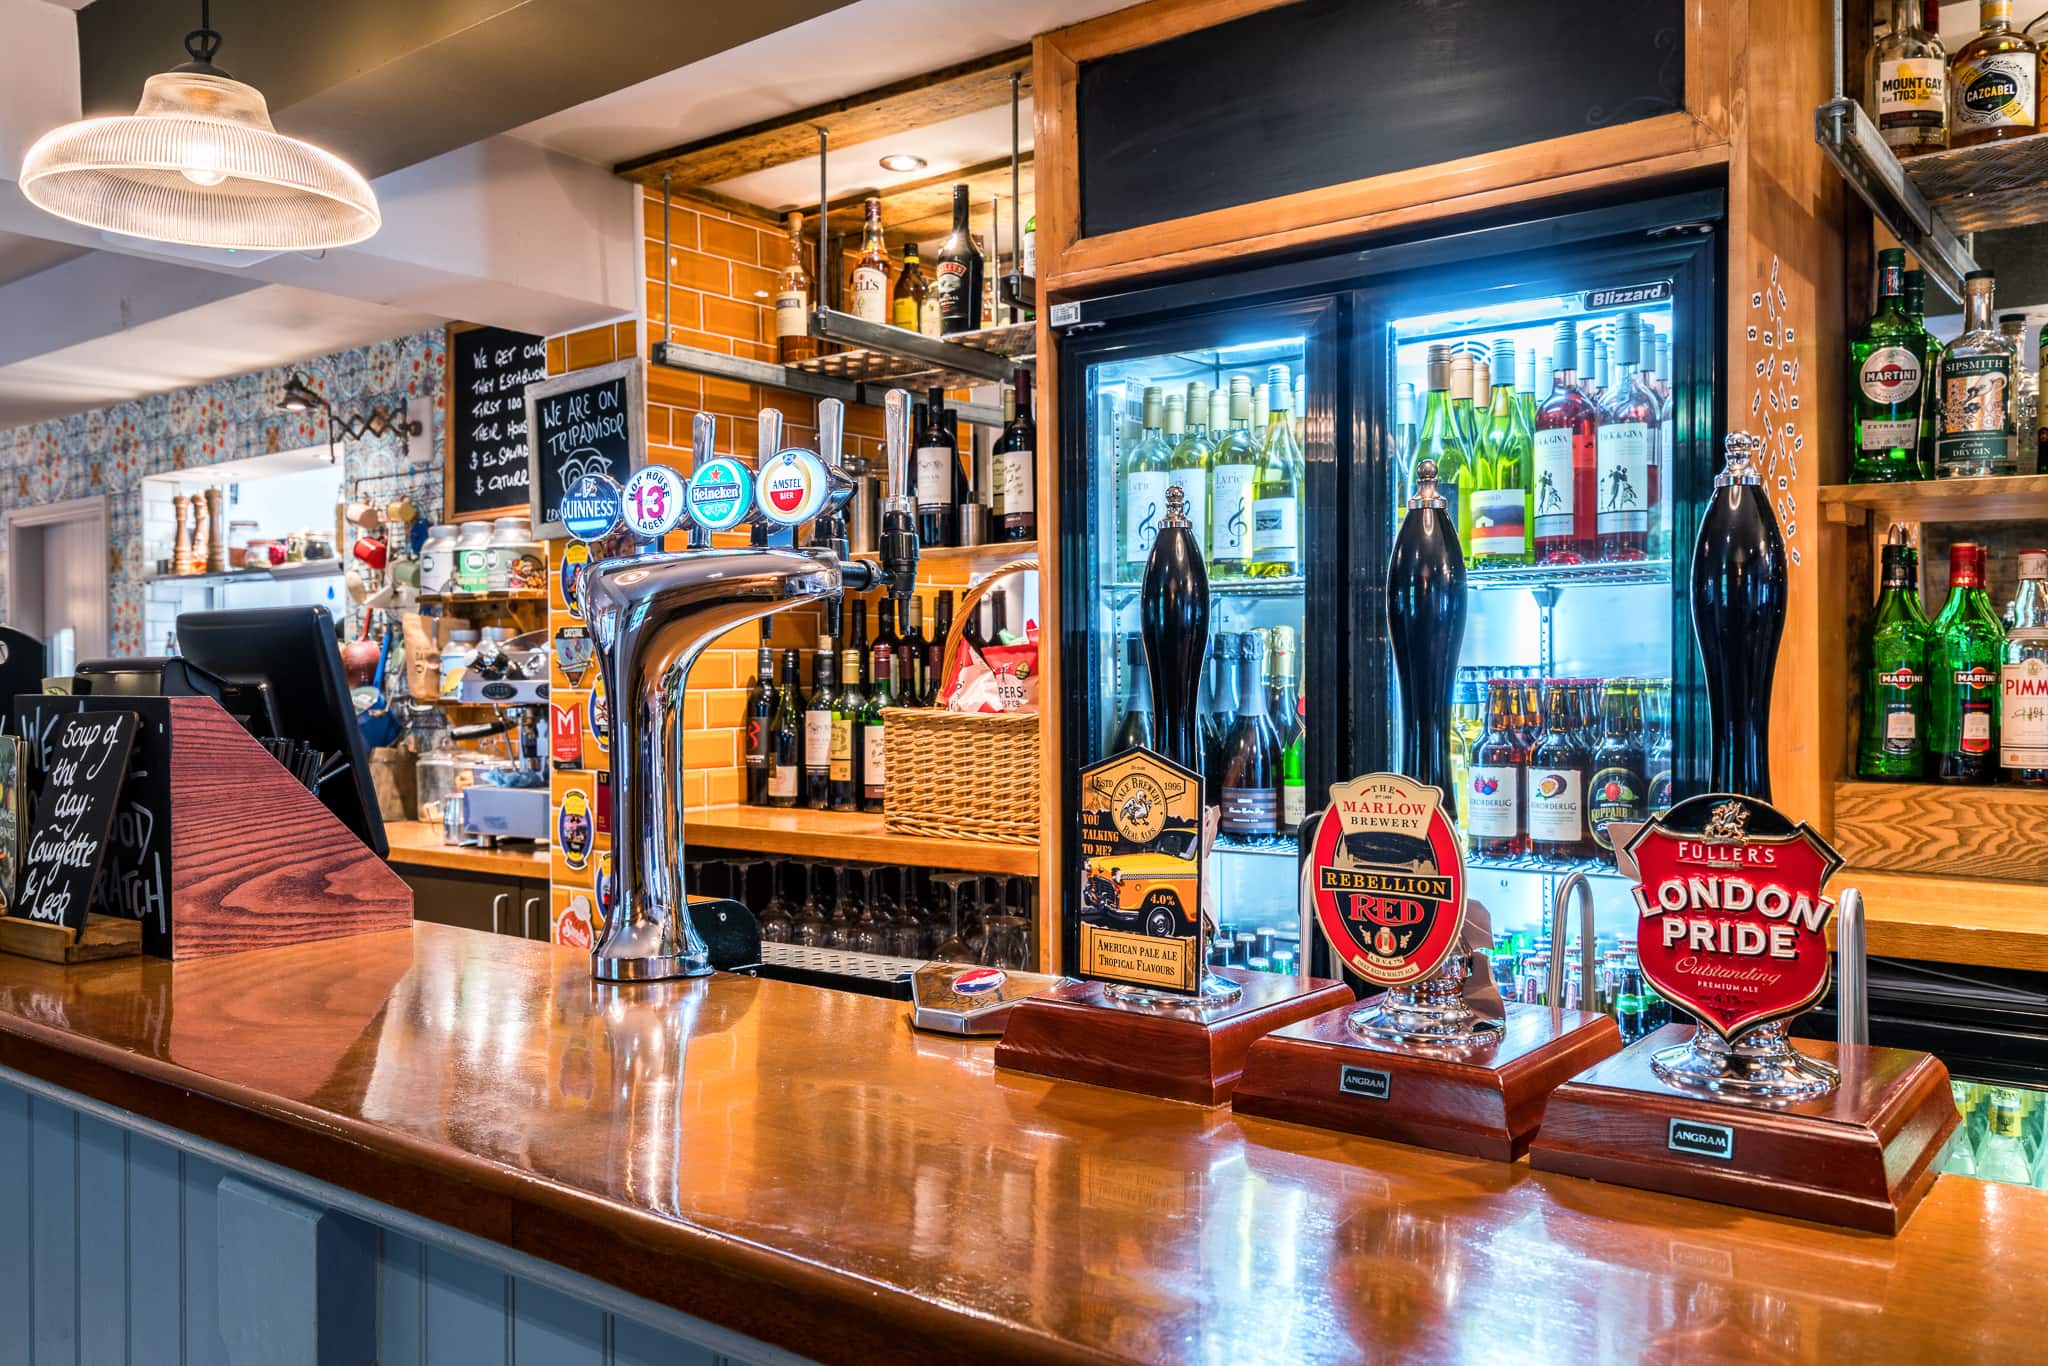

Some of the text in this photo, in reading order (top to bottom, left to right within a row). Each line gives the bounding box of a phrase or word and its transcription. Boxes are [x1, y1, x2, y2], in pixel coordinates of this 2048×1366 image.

[1882, 77, 1942, 92] MOUNT GAY
[1966, 83, 2016, 103] CAZCABEL
[1893, 90, 1917, 101] 1703
[855, 279, 880, 292] ELL'S
[1592, 285, 1663, 307] Blizzard
[473, 347, 488, 369] WE
[495, 346, 517, 367] GET
[1946, 359, 2004, 373] SIPSMITH
[1866, 369, 1917, 382] MARTINI
[472, 377, 494, 395] THEY
[472, 399, 502, 418] FIRST
[544, 381, 619, 429] WE ARE ON
[507, 420, 528, 440] HOUS
[547, 412, 627, 456] TRIPADVISOR
[482, 451, 497, 467] EL
[498, 444, 528, 466] SALVAD
[1952, 447, 1991, 457] DRY GIN
[488, 469, 530, 490] CATURR
[628, 471, 670, 501] HOP HOUSE
[772, 478, 801, 489] AMSTEL
[633, 485, 665, 520] 13
[692, 486, 739, 502] Heineken
[779, 491, 795, 501] BIER
[561, 498, 614, 519] GUINNESS
[637, 515, 665, 530] LAGER
[1882, 675, 1923, 683] MARTINI
[2005, 679, 2048, 696] PIMM
[998, 686, 1023, 698] PERS
[557, 709, 574, 735] M
[21, 705, 59, 772] WE
[62, 715, 124, 780] Soup of
[52, 758, 78, 787] the
[1115, 783, 1132, 803] VALE
[1131, 777, 1162, 806] BREWERY
[1371, 784, 1396, 794] THE
[54, 789, 95, 840] day:
[1342, 800, 1427, 816] MARLOW
[1082, 813, 1100, 826] YOU
[1350, 816, 1419, 829] BREWERY
[1082, 829, 1119, 842] TALKING
[27, 829, 98, 886] Courgette
[1082, 843, 1112, 856] TO ME?
[1678, 841, 1775, 864] FULLER'S
[1325, 872, 1447, 896] REBELLION
[28, 875, 71, 926] Leek
[1150, 894, 1176, 906] 4.0%
[1348, 893, 1425, 927] RED
[1631, 876, 1836, 933] LONDON
[1661, 917, 1799, 960] PRIDE
[1097, 939, 1177, 961] AMERICAN PALE ALE
[1099, 954, 1175, 976] TROPICAL FLAVOURS
[1675, 956, 1782, 986] Outstanding
[1697, 980, 1740, 991] PREMIUM
[1345, 1074, 1386, 1090] ANGRAM
[1674, 1130, 1728, 1149] ANGRAM
